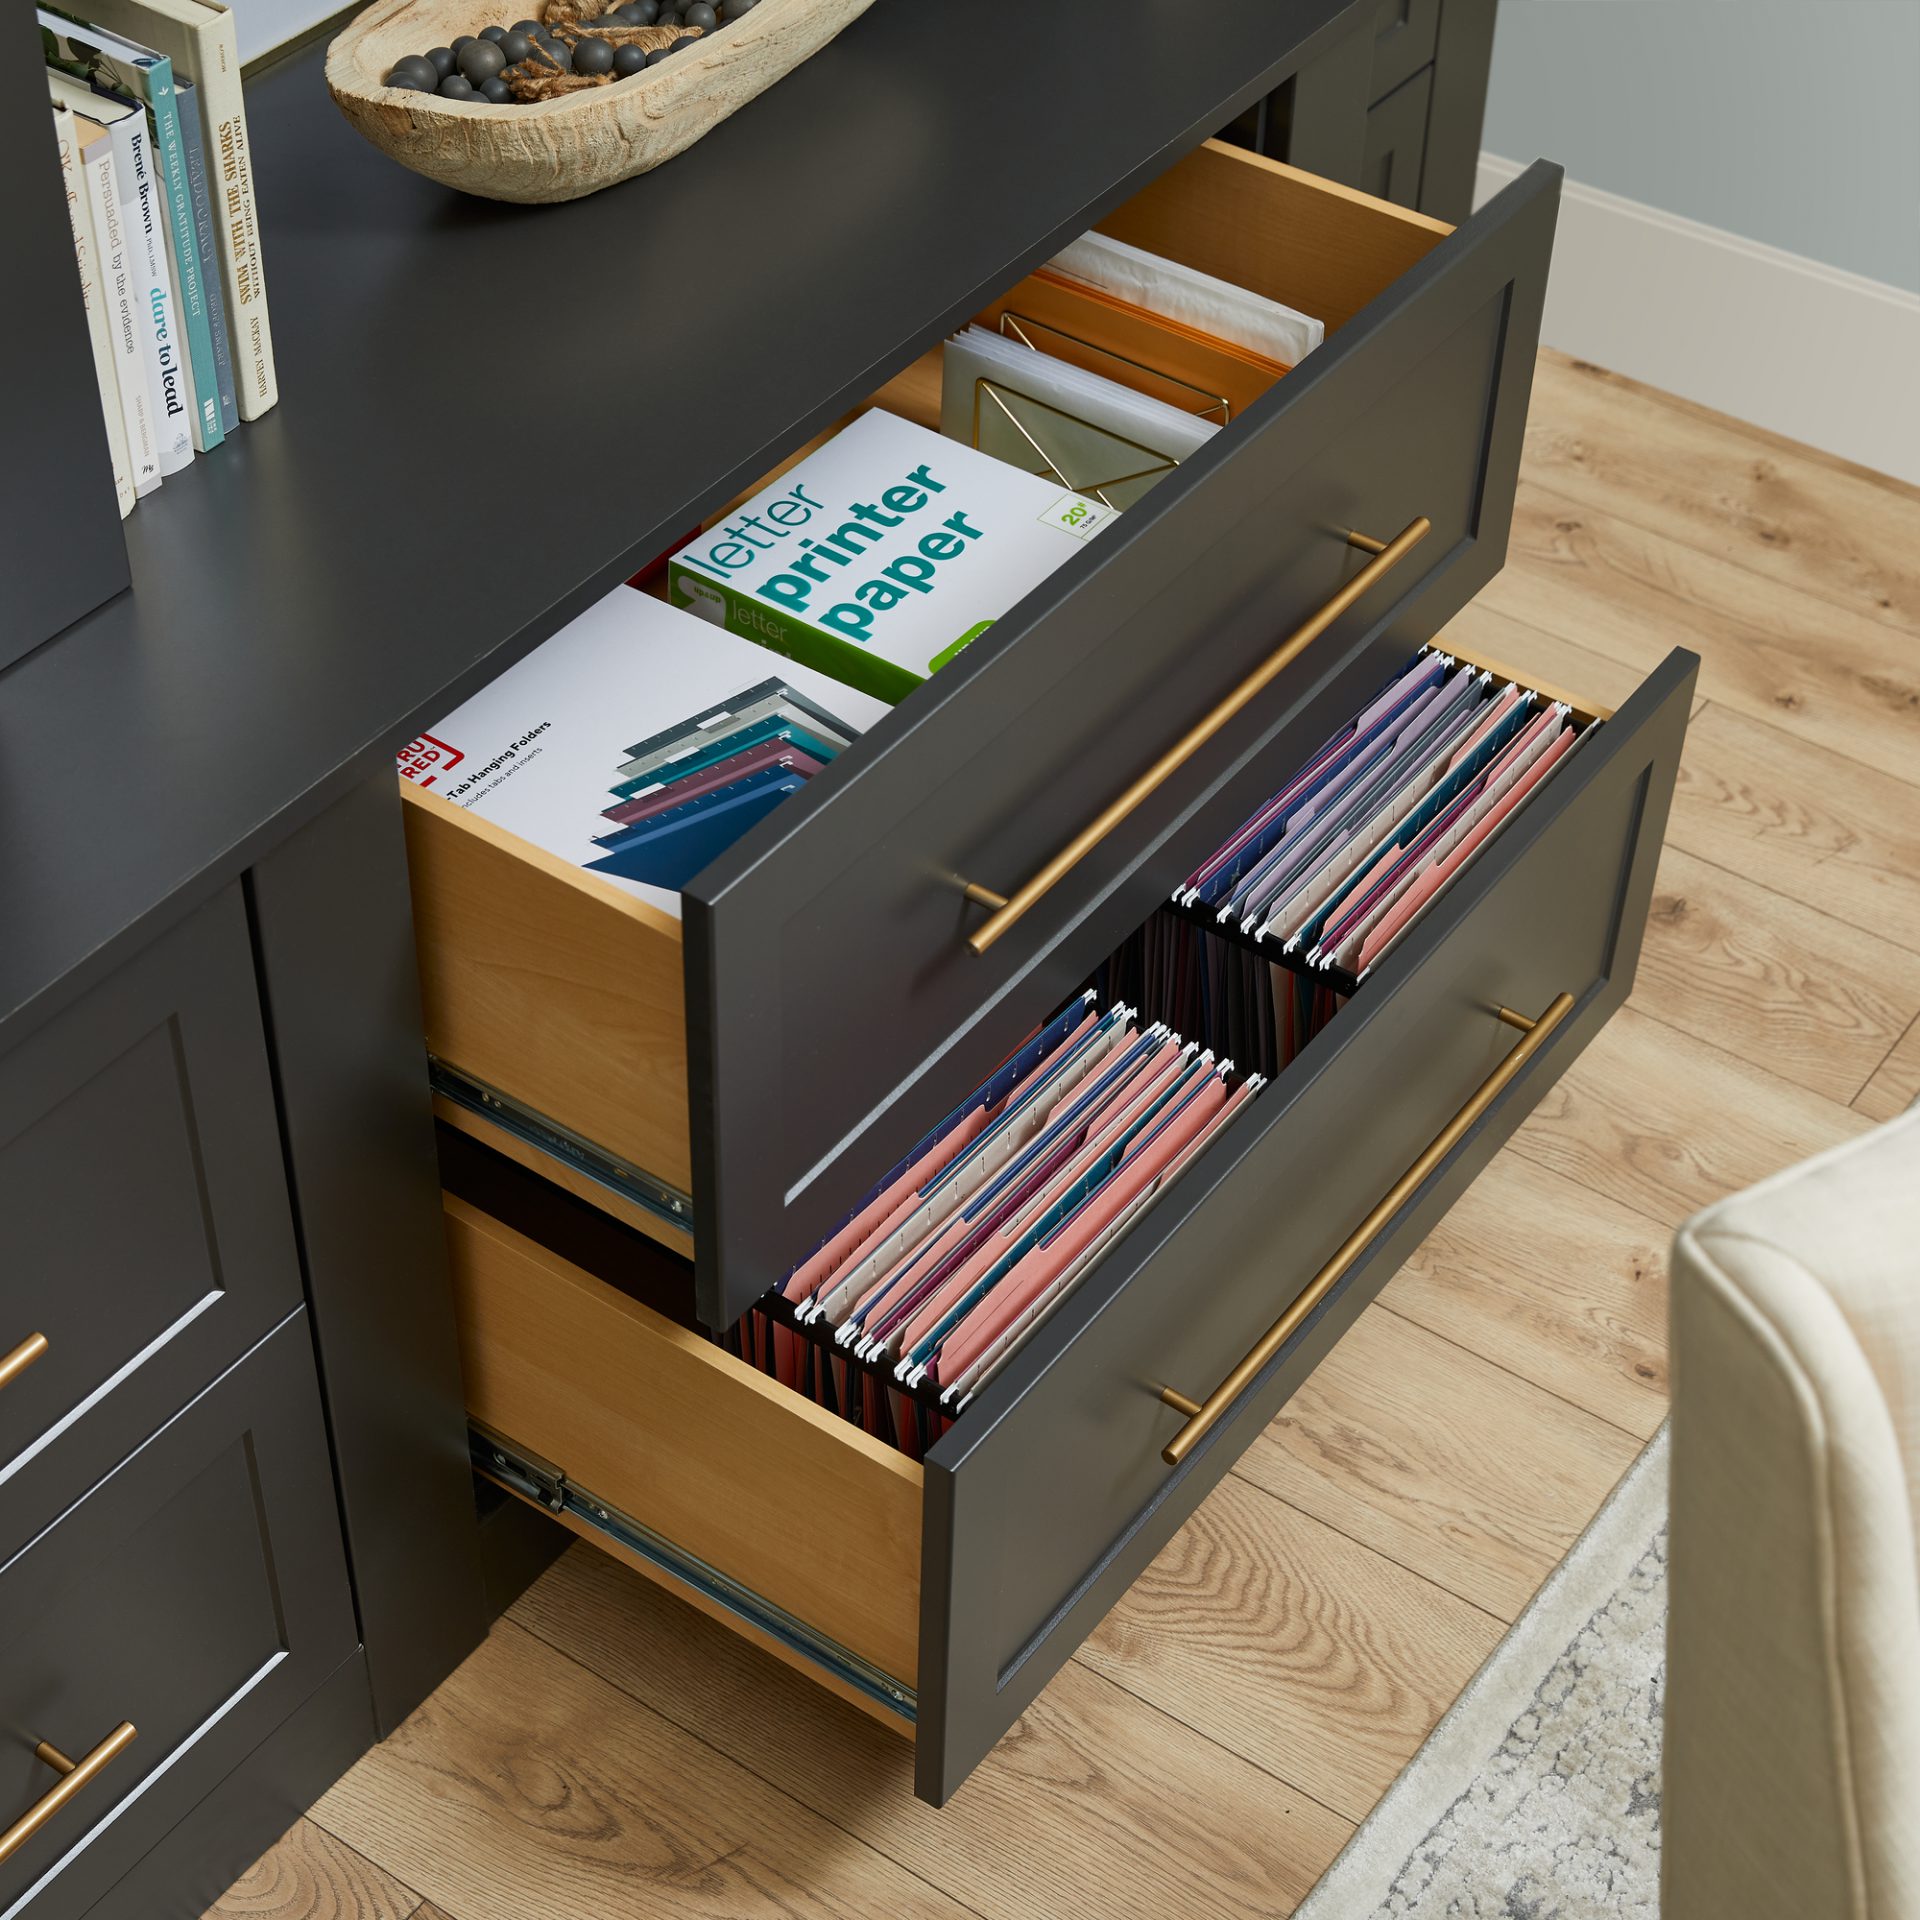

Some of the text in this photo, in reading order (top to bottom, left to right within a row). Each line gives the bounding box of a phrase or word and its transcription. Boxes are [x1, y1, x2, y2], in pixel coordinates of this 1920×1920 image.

[131, 132, 146, 180] Brené
[163, 111, 201, 317] THE WEEKLY GRATITUDE PROJECT
[218, 120, 252, 305] SWIM WITH THE SHARKS
[232, 115, 261, 299] WITHOUT BEING EATEN ALIVE
[99, 160, 134, 354] Persuaded by the evidence
[150, 287, 168, 341] dare
[158, 343, 171, 366] to
[161, 363, 183, 418] lead
[250, 316, 267, 398] HARVEY MACKAY
[682, 483, 825, 579] letter
[755, 464, 947, 613] printer
[817, 510, 985, 642] paper
[733, 599, 788, 641] letter
[396, 740, 426, 768] RU
[446, 720, 552, 800] -Tab Hanging Folders
[461, 747, 543, 808] ncludes tabs and inserts
